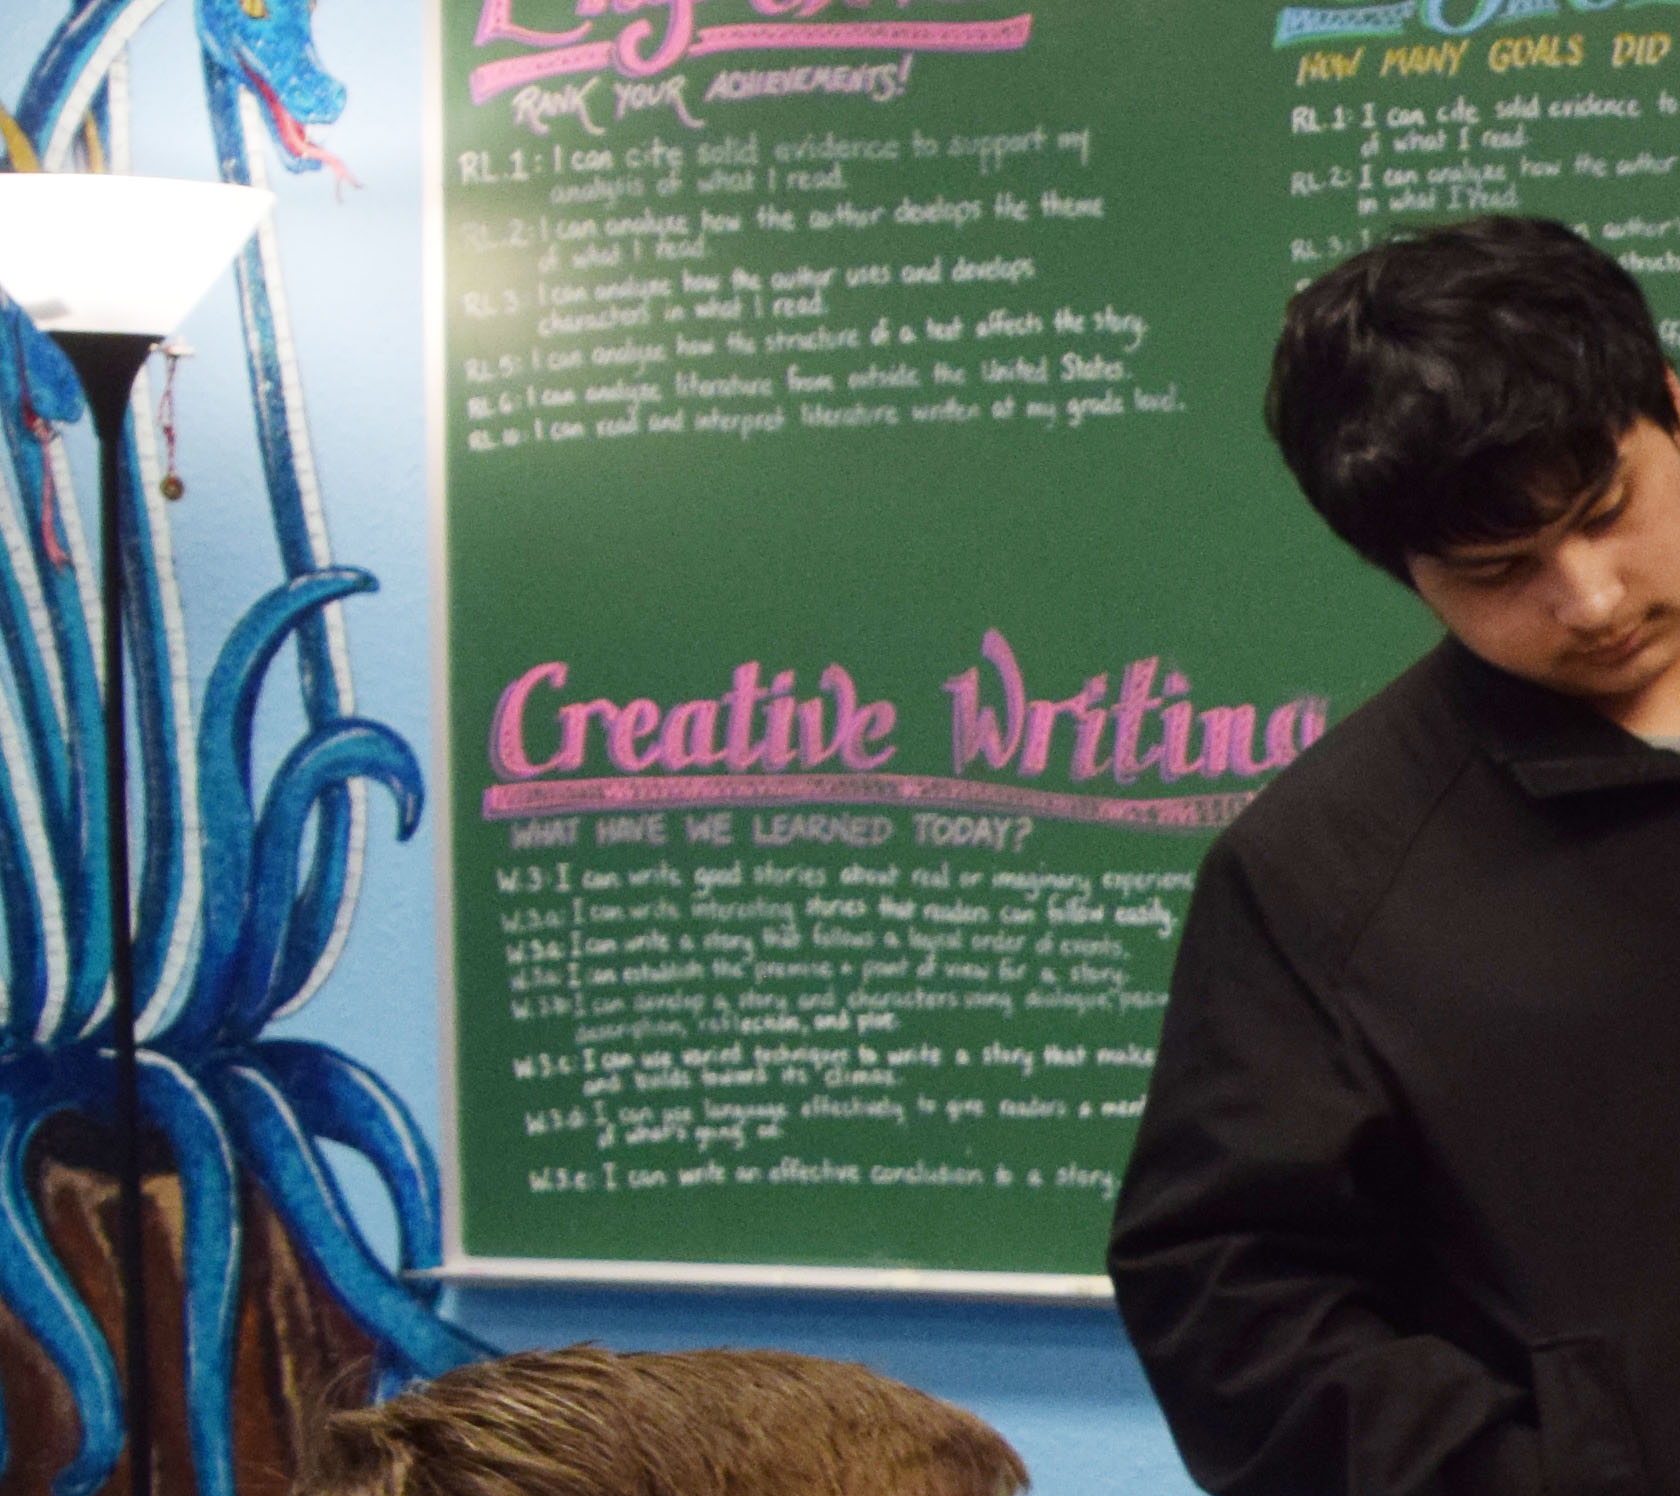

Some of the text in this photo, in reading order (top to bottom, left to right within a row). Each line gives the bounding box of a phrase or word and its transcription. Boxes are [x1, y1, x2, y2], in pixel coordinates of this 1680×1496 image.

[1296, 46, 1366, 86] HOW
[1379, 38, 1470, 77] MANY
[1488, 33, 1584, 73] GOALS
[1611, 31, 1672, 68] DID
[512, 76, 606, 137] RANK
[613, 74, 705, 129] YOUR
[1291, 105, 1352, 133] RL.1:
[1361, 102, 1377, 128] I
[1386, 106, 1426, 127] can
[1435, 95, 1480, 125] cite
[1495, 92, 1540, 119] solid
[1548, 91, 1641, 118] evidence
[1659, 90, 1679, 114] to
[489, 659, 898, 778] Creative
[511, 813, 1034, 852] WHAT HAVE WE LEARNED TODAY?
